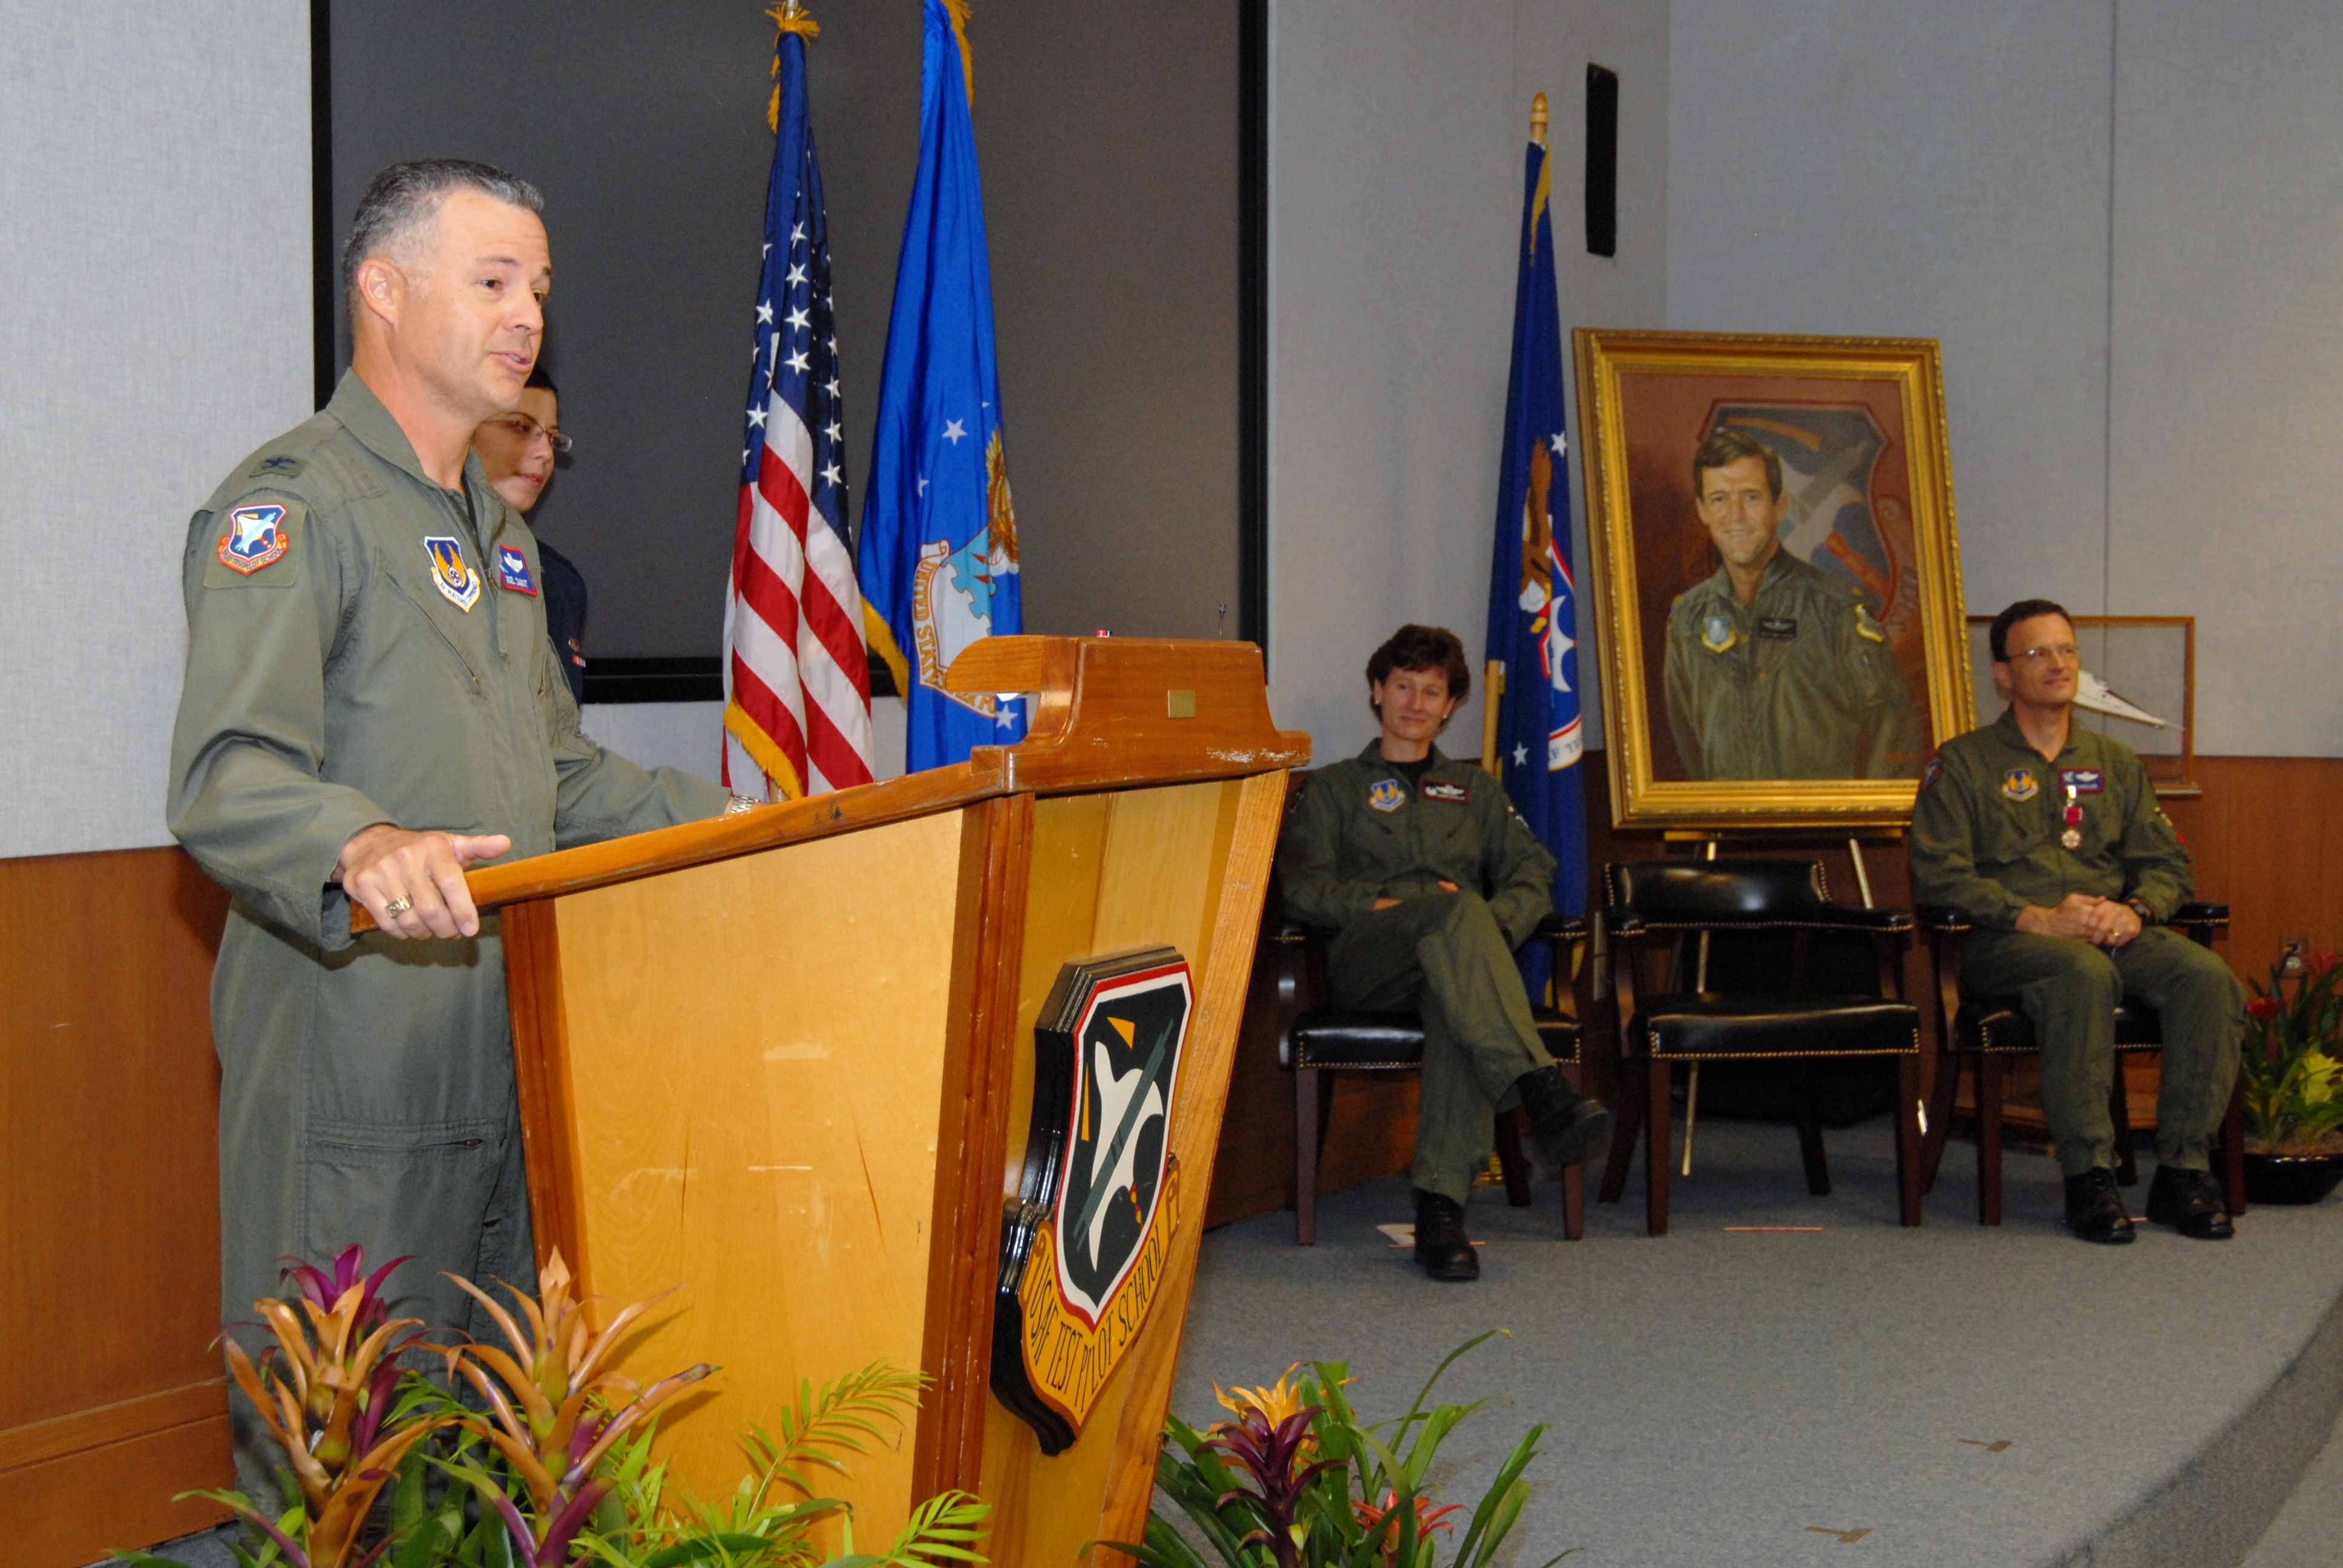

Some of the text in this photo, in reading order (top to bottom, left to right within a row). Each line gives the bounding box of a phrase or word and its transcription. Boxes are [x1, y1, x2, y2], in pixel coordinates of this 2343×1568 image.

[914, 560, 946, 690] UNITED STATE
[1029, 1224, 1164, 1414] USAF TEST PILOT SCHOOL
